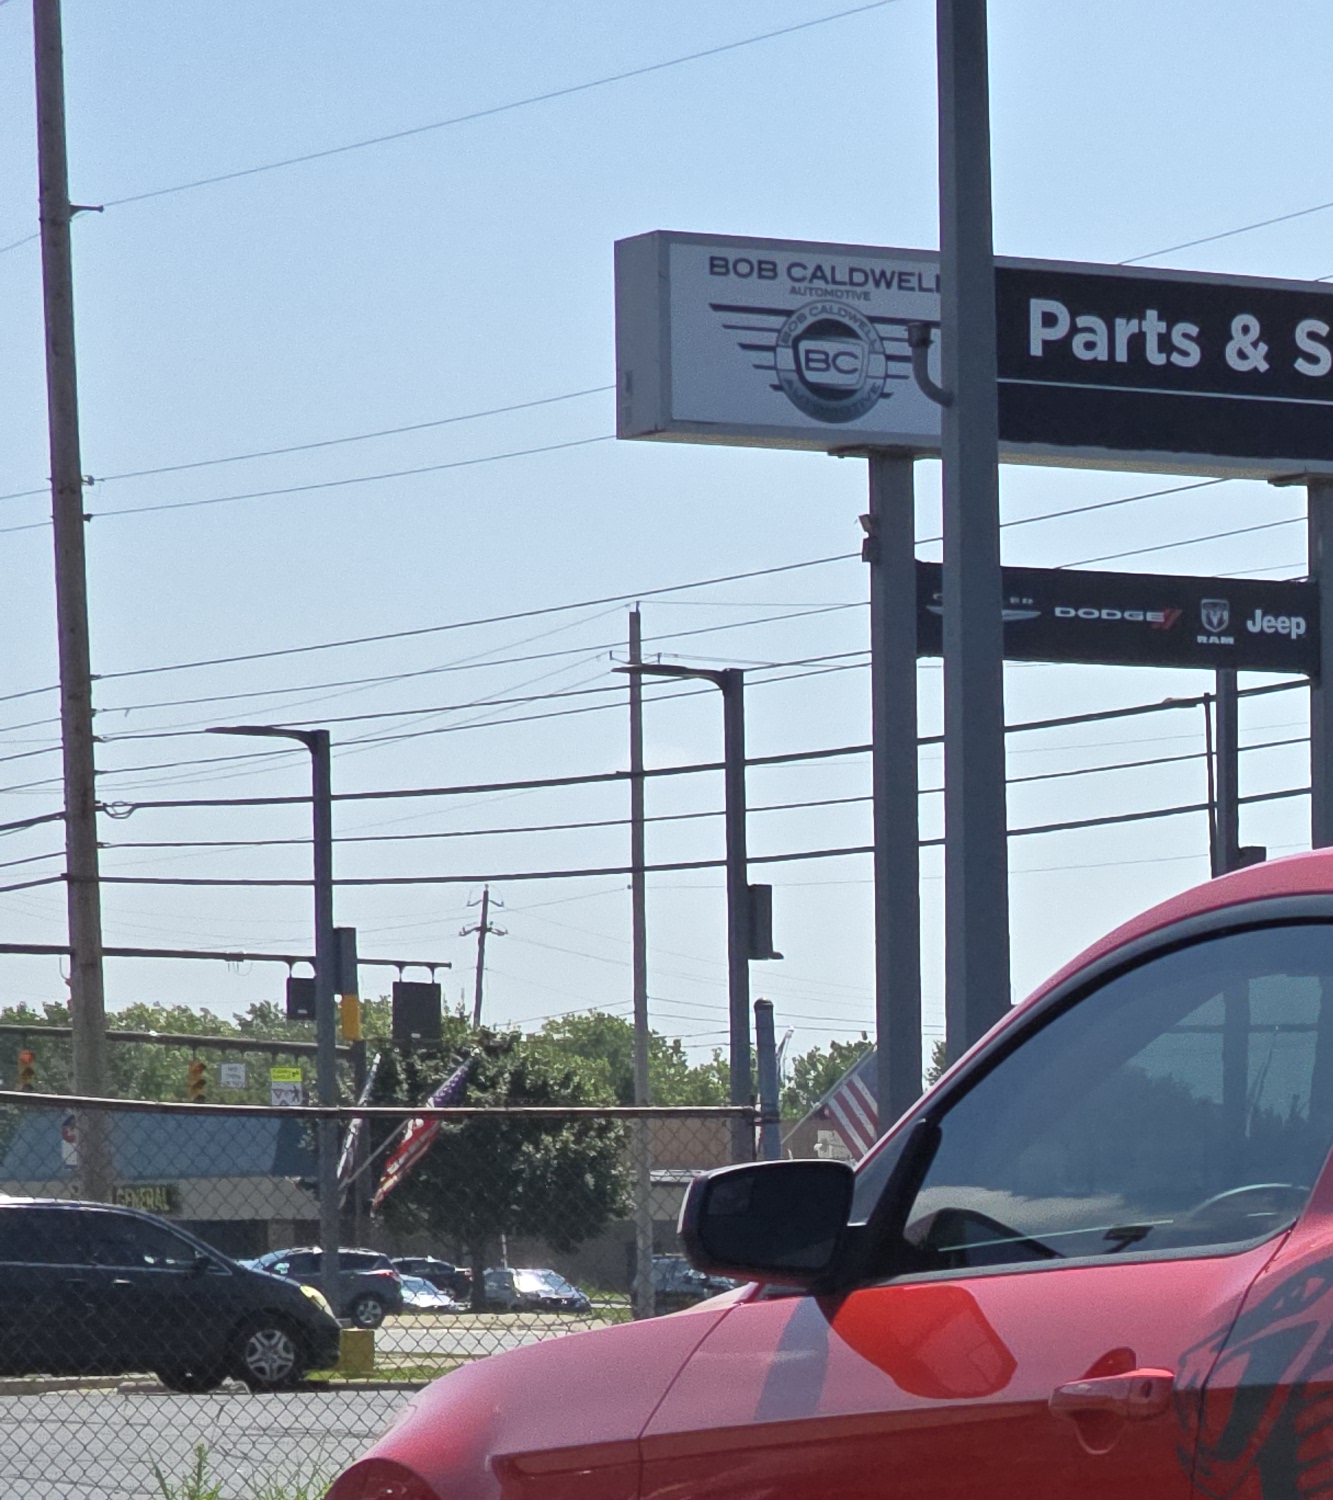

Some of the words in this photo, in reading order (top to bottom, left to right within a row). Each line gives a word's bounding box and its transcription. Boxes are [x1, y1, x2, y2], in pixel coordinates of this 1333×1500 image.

[708, 255, 778, 280] BOB
[789, 285, 872, 301] AUTOMOTIVE
[780, 311, 808, 345] BOB
[808, 304, 880, 351] CALDWELL
[1028, 298, 1202, 369] Parts
[1225, 313, 1271, 373] &
[804, 348, 860, 375] BC
[1054, 606, 1166, 623] DODGE
[1246, 609, 1307, 640] Jeep
[1196, 634, 1235, 645] RAM
